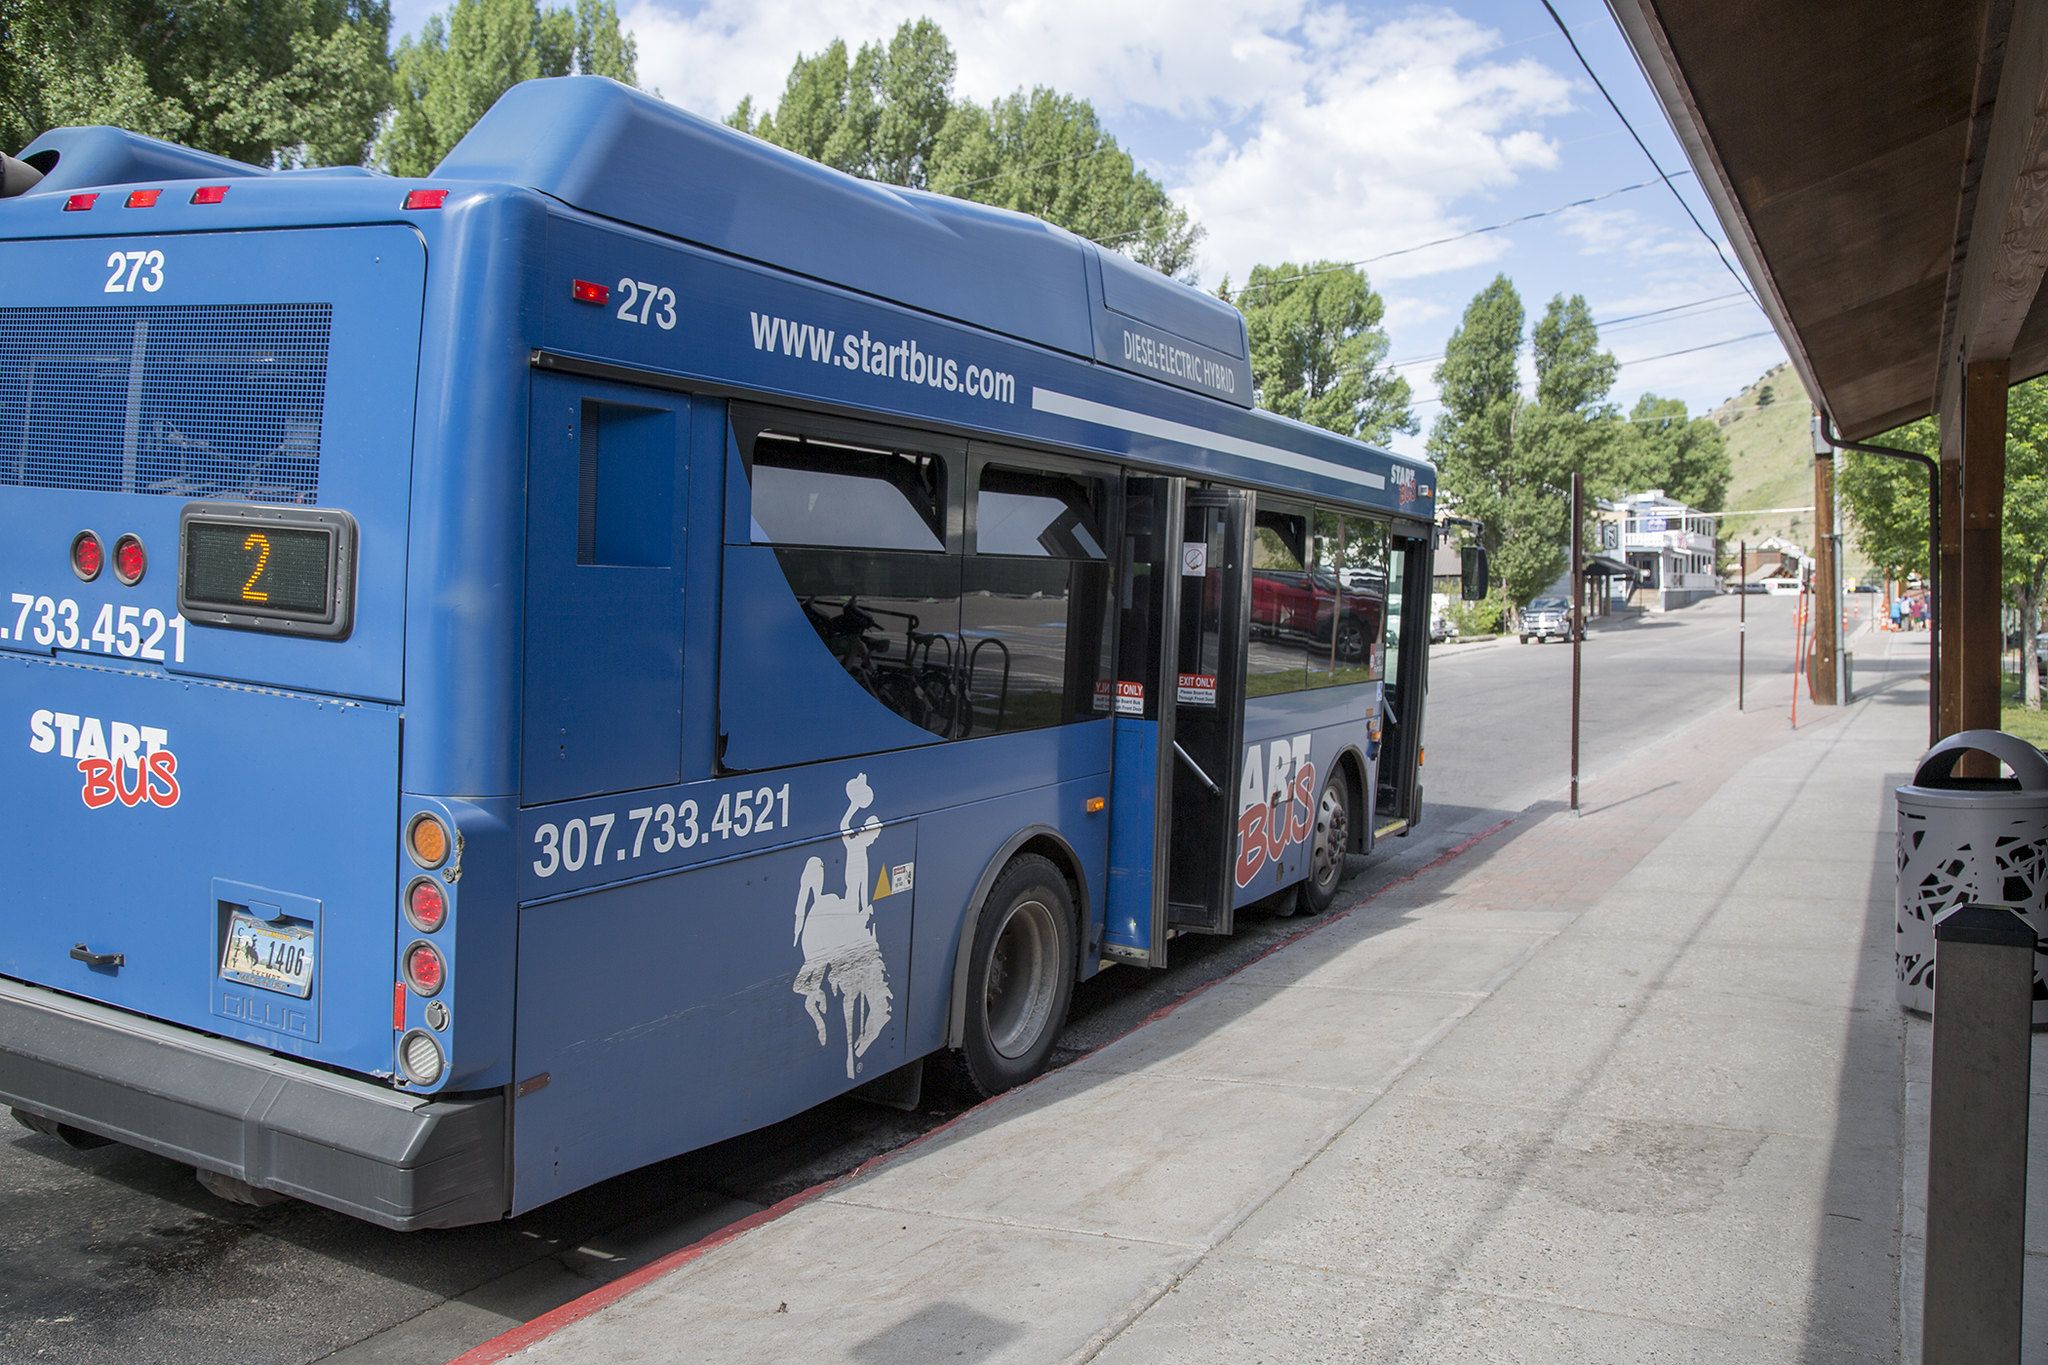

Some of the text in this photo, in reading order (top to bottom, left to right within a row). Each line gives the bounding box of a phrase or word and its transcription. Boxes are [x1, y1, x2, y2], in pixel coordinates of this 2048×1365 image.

[104, 249, 165, 293] 273
[616, 277, 677, 330] 273
[750, 311, 1015, 404] www.startbus.com
[1123, 329, 1235, 394] DIESEL-ELECTRIC HYBRID
[1390, 464, 1415, 487] START
[1399, 479, 1417, 505] BUS
[242, 533, 270, 601] 2
[1123, 684, 1144, 696] ONLY
[1179, 676, 1215, 688] EXIT ONLY
[29, 709, 168, 771] START
[77, 750, 181, 810] BUS
[1238, 733, 1312, 815] ART
[533, 783, 790, 878] 307.733.4521
[1235, 762, 1315, 888] BUS
[266, 941, 305, 976] 1406
[271, 980, 286, 991] USA
[223, 992, 307, 1035] GILLIG
